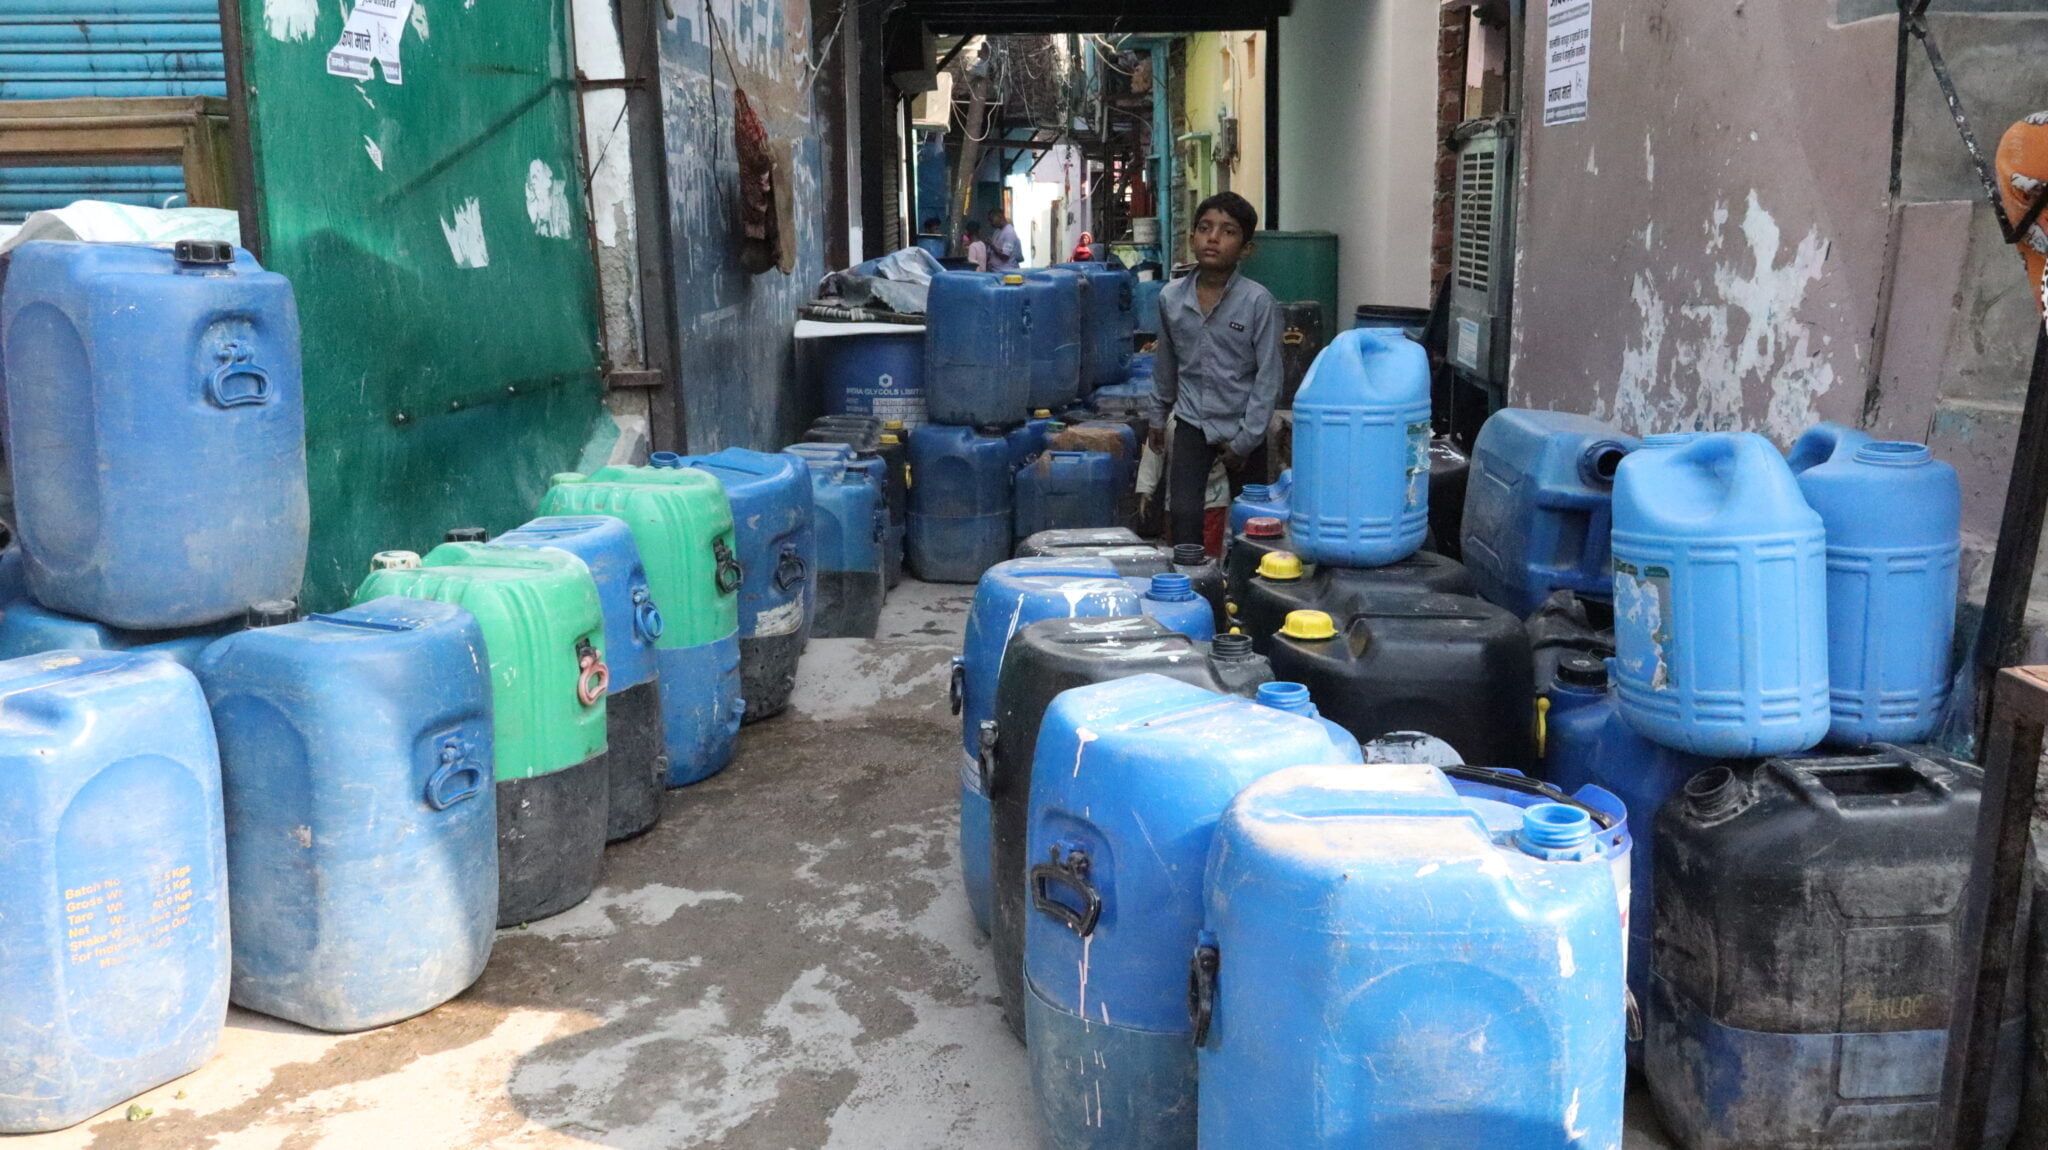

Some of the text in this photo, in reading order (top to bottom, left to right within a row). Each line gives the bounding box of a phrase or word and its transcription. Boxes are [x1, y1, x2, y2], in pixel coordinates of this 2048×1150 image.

[65, 882, 100, 900] Batch
[66, 896, 103, 912] Gross
[66, 912, 94, 926] Tare
[68, 924, 91, 939] Net
[69, 936, 107, 952] Shake
[71, 953, 92, 966] For
